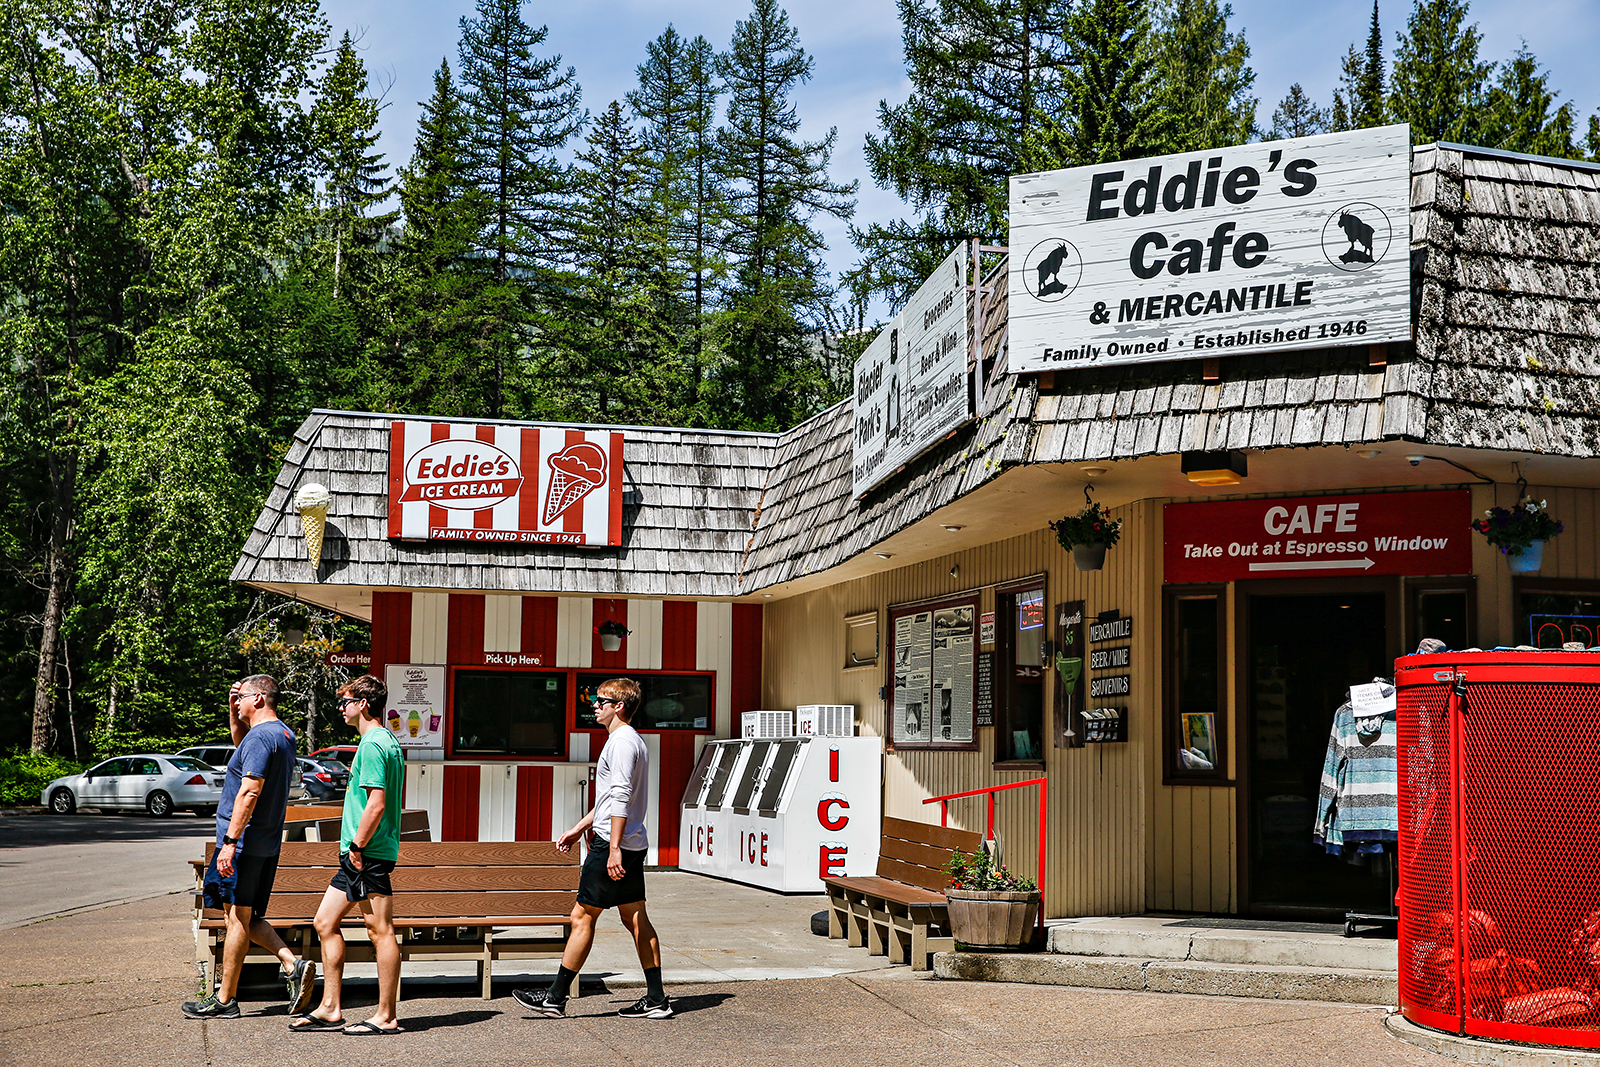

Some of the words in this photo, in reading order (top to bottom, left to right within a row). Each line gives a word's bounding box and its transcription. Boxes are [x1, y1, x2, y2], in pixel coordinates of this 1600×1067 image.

[1086, 149, 1318, 222] Eddie's
[1129, 221, 1269, 279] Cafe
[924, 290, 953, 331] Groceries
[1089, 301, 1110, 325] &
[1118, 280, 1314, 322] MERCANTILE
[920, 351, 934, 377] Beer
[941, 331, 958, 358] Wine
[1043, 345, 1101, 362] Family
[1107, 338, 1168, 355] Owned
[1194, 325, 1310, 350] Established
[1317, 320, 1368, 339] 1946
[858, 359, 884, 407] Glacier
[917, 394, 934, 421] Camp
[934, 372, 962, 407] Supplies
[858, 402, 881, 449] Park's
[417, 453, 510, 479] Eddie's
[420, 485, 444, 498] ICE
[448, 482, 504, 497] CREAM
[432, 529, 474, 540] FAMILY
[475, 530, 517, 542] OWNED
[520, 532, 552, 543] SINCE
[555, 534, 581, 543] 1946
[1263, 502, 1360, 536] CAFE
[1183, 543, 1223, 558] Take
[1227, 541, 1258, 556] Out
[1262, 540, 1281, 555] at
[1285, 537, 1368, 557] Espresso
[1374, 535, 1449, 552] Window
[1090, 619, 1131, 642] MERCANTILE
[330, 655, 355, 664] Order
[356, 655, 371, 664] Her
[486, 655, 503, 664] Pick
[504, 656, 517, 667] Up
[519, 656, 540, 665] Here
[1091, 649, 1128, 668] BEER/WINE
[1091, 677, 1128, 697] SOUVENIRS
[744, 724, 755, 737] ICE
[800, 720, 812, 734] ICE
[817, 744, 849, 878] ICE
[689, 822, 714, 857] ICE
[739, 827, 769, 867] ICE
